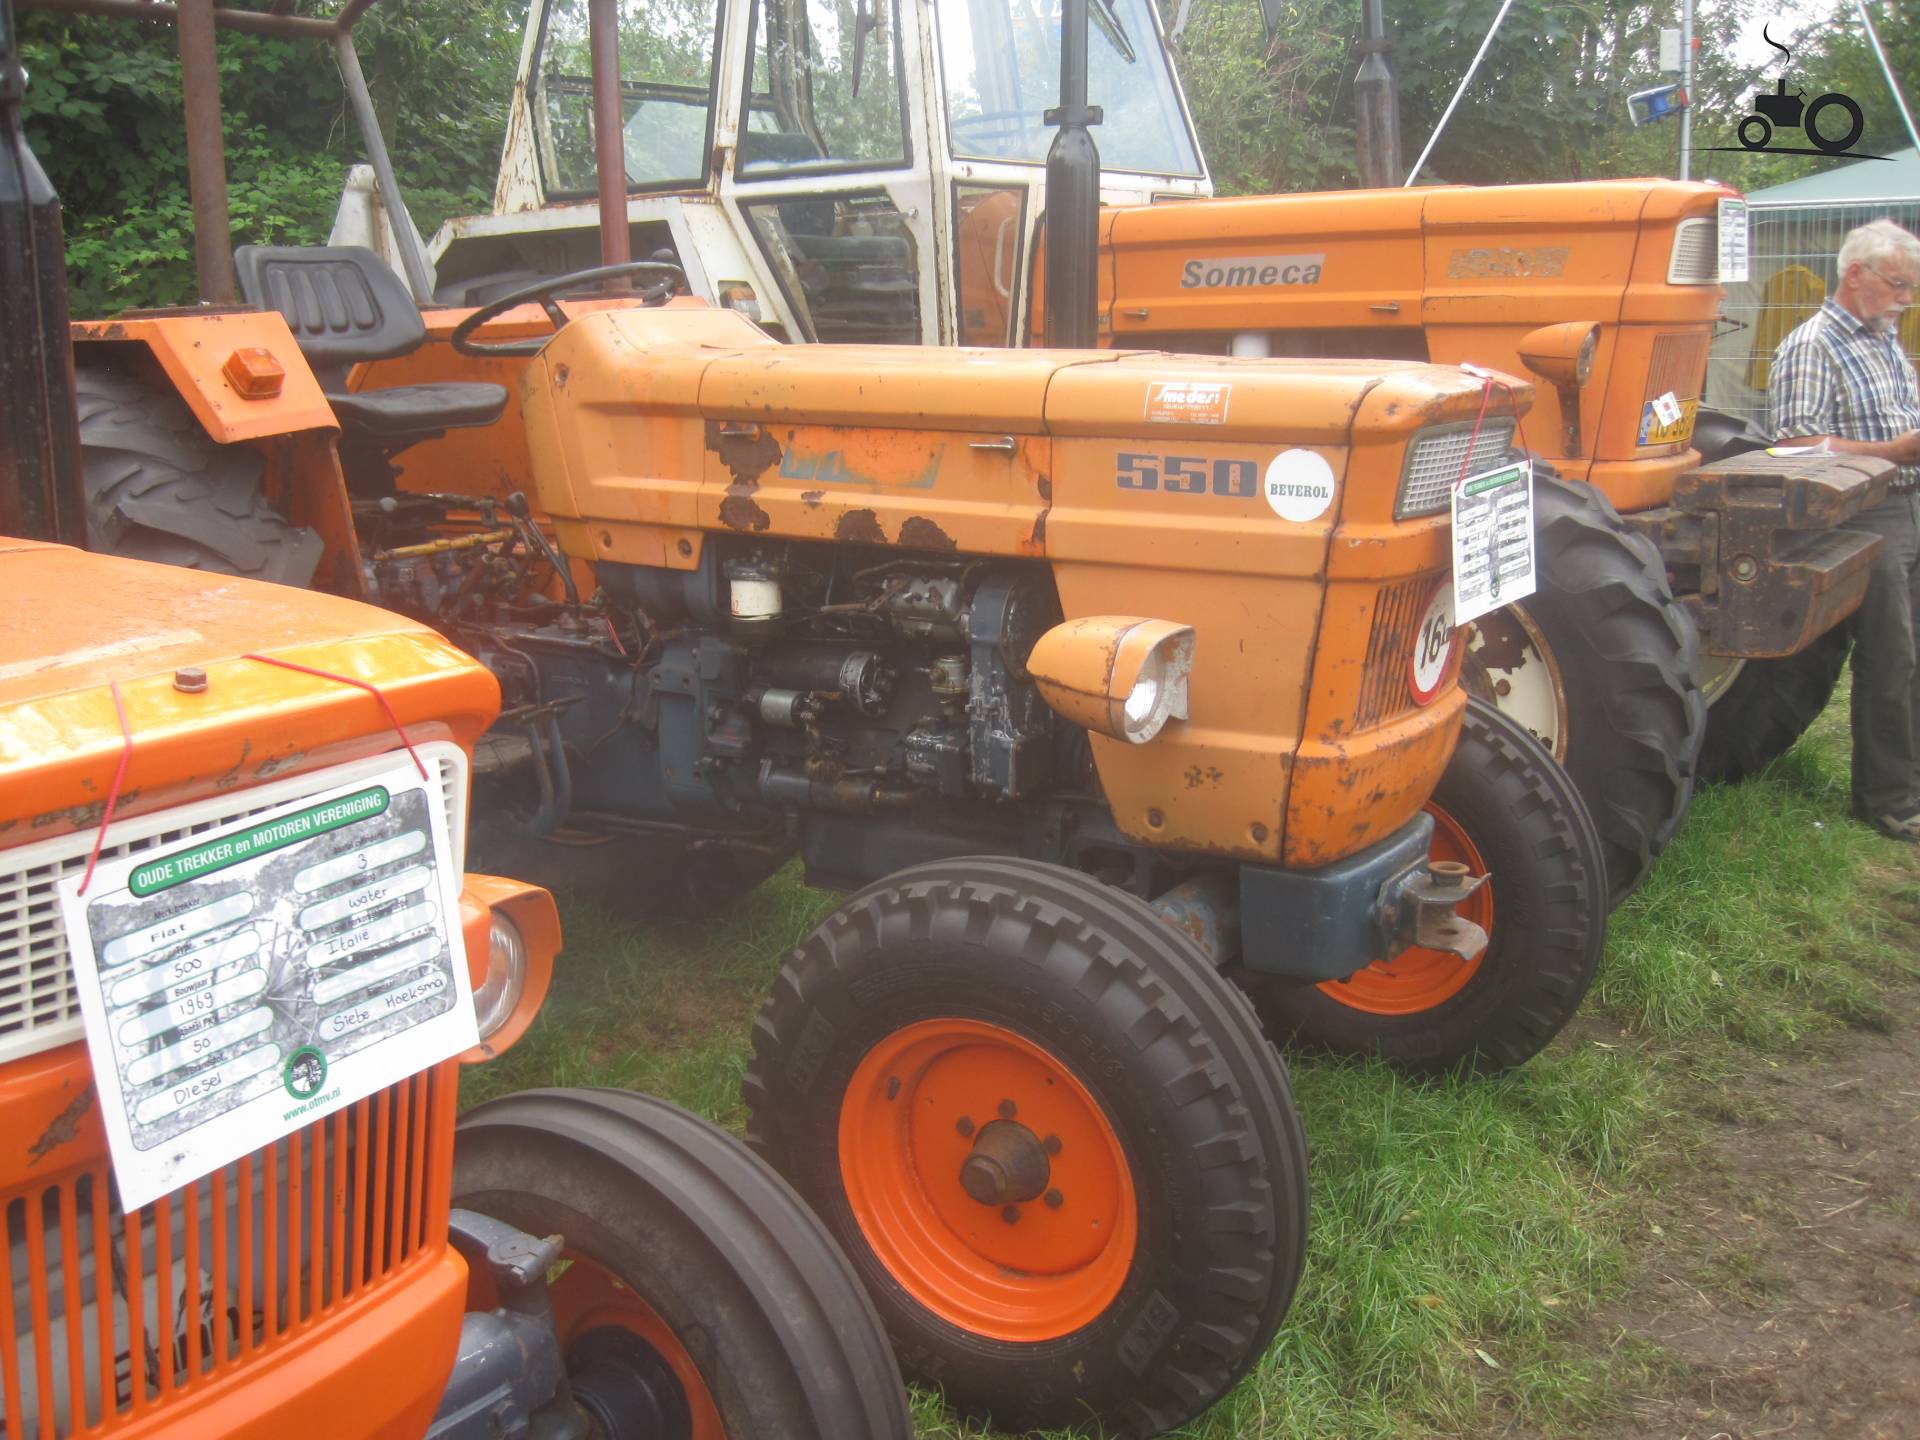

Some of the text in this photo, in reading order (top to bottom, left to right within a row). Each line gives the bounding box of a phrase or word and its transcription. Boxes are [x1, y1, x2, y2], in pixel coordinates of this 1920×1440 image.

[1181, 260, 1322, 288] Someca
[1117, 452, 1258, 498] 550
[1270, 483, 1329, 499] BEVEROL
[138, 863, 174, 888] OUDE
[175, 843, 233, 875] TREKKER
[235, 840, 251, 854] en
[253, 816, 311, 848] MOTOREN
[313, 793, 382, 827] VERENIGING
[358, 853, 368, 869] 3
[349, 888, 388, 908] water
[174, 958, 202, 978] 500
[180, 992, 214, 1015] 1969
[193, 1038, 211, 1053] 50
[283, 1087, 341, 1121] www.otmv.nl
